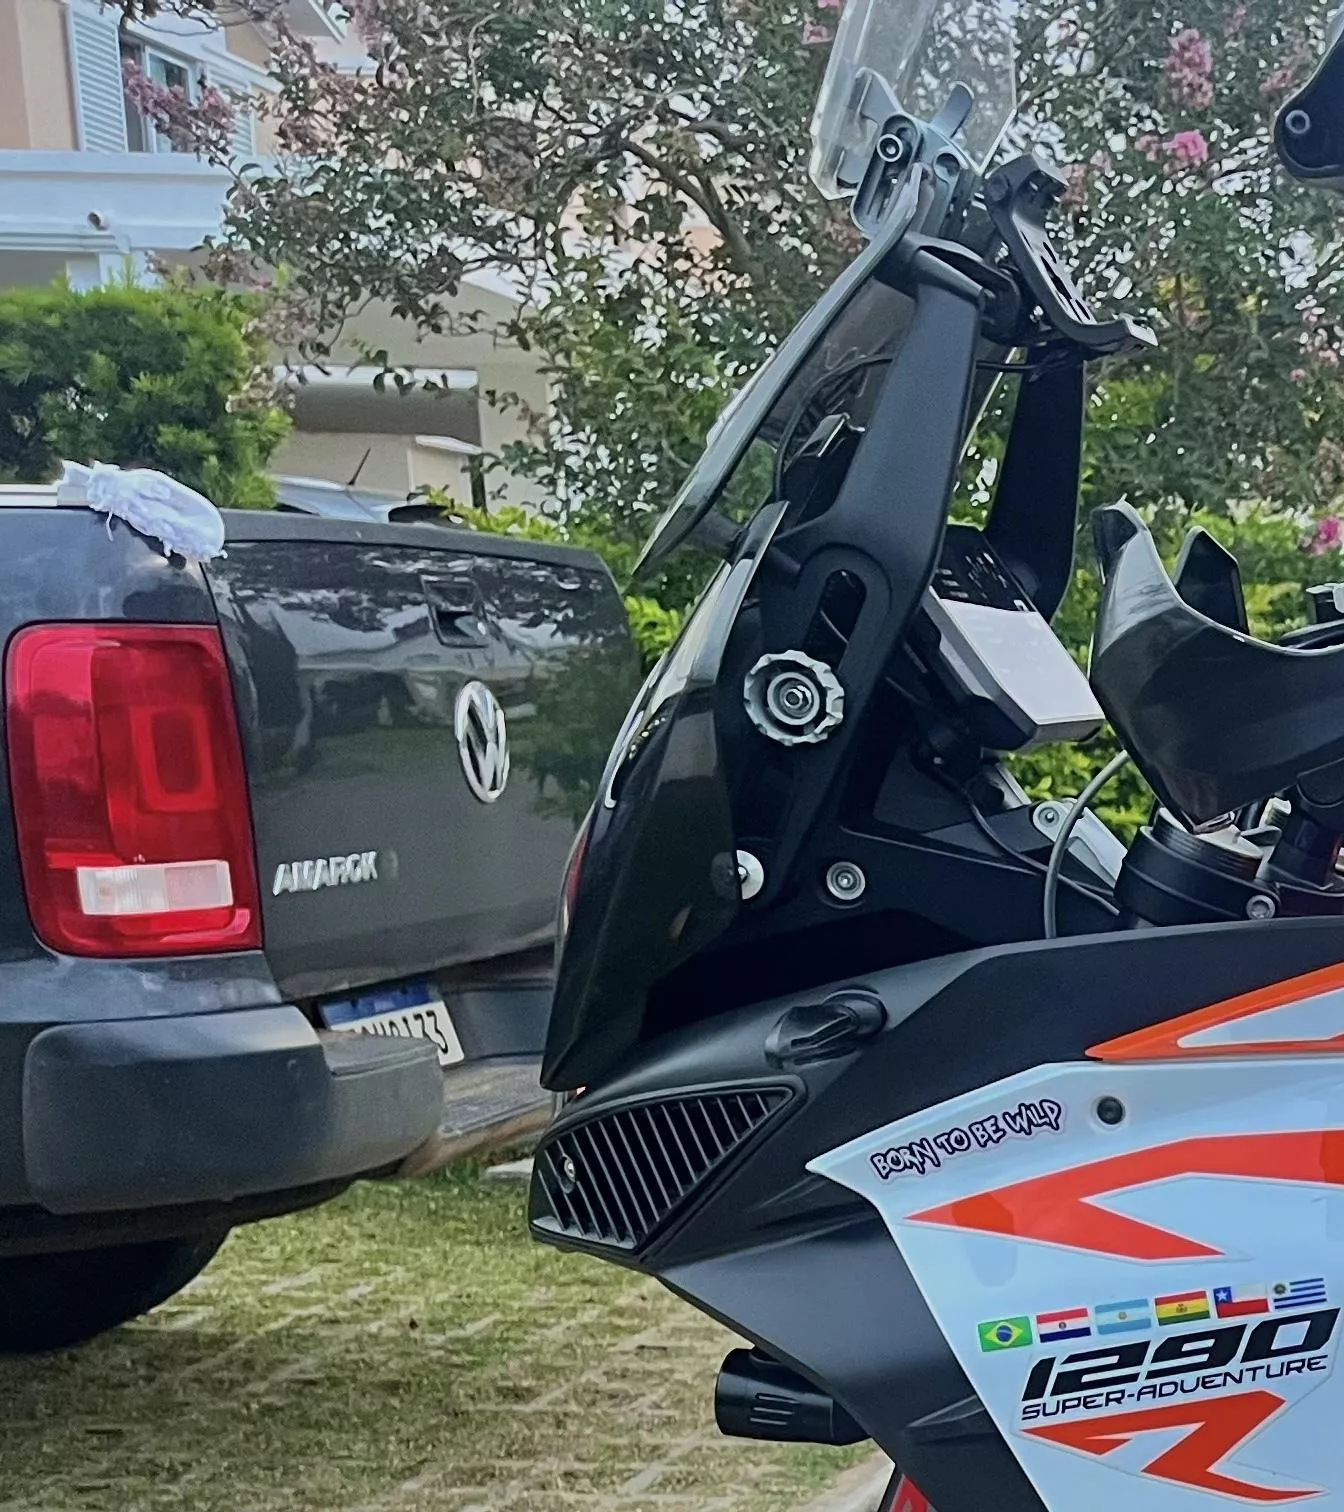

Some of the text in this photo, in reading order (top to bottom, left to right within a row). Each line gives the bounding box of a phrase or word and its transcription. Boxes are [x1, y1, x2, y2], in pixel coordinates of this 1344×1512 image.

[871, 1137, 941, 1180] BORN
[933, 1127, 971, 1155] TO
[968, 1115, 1007, 1148] BE
[1022, 1308, 1340, 1401] 1290
